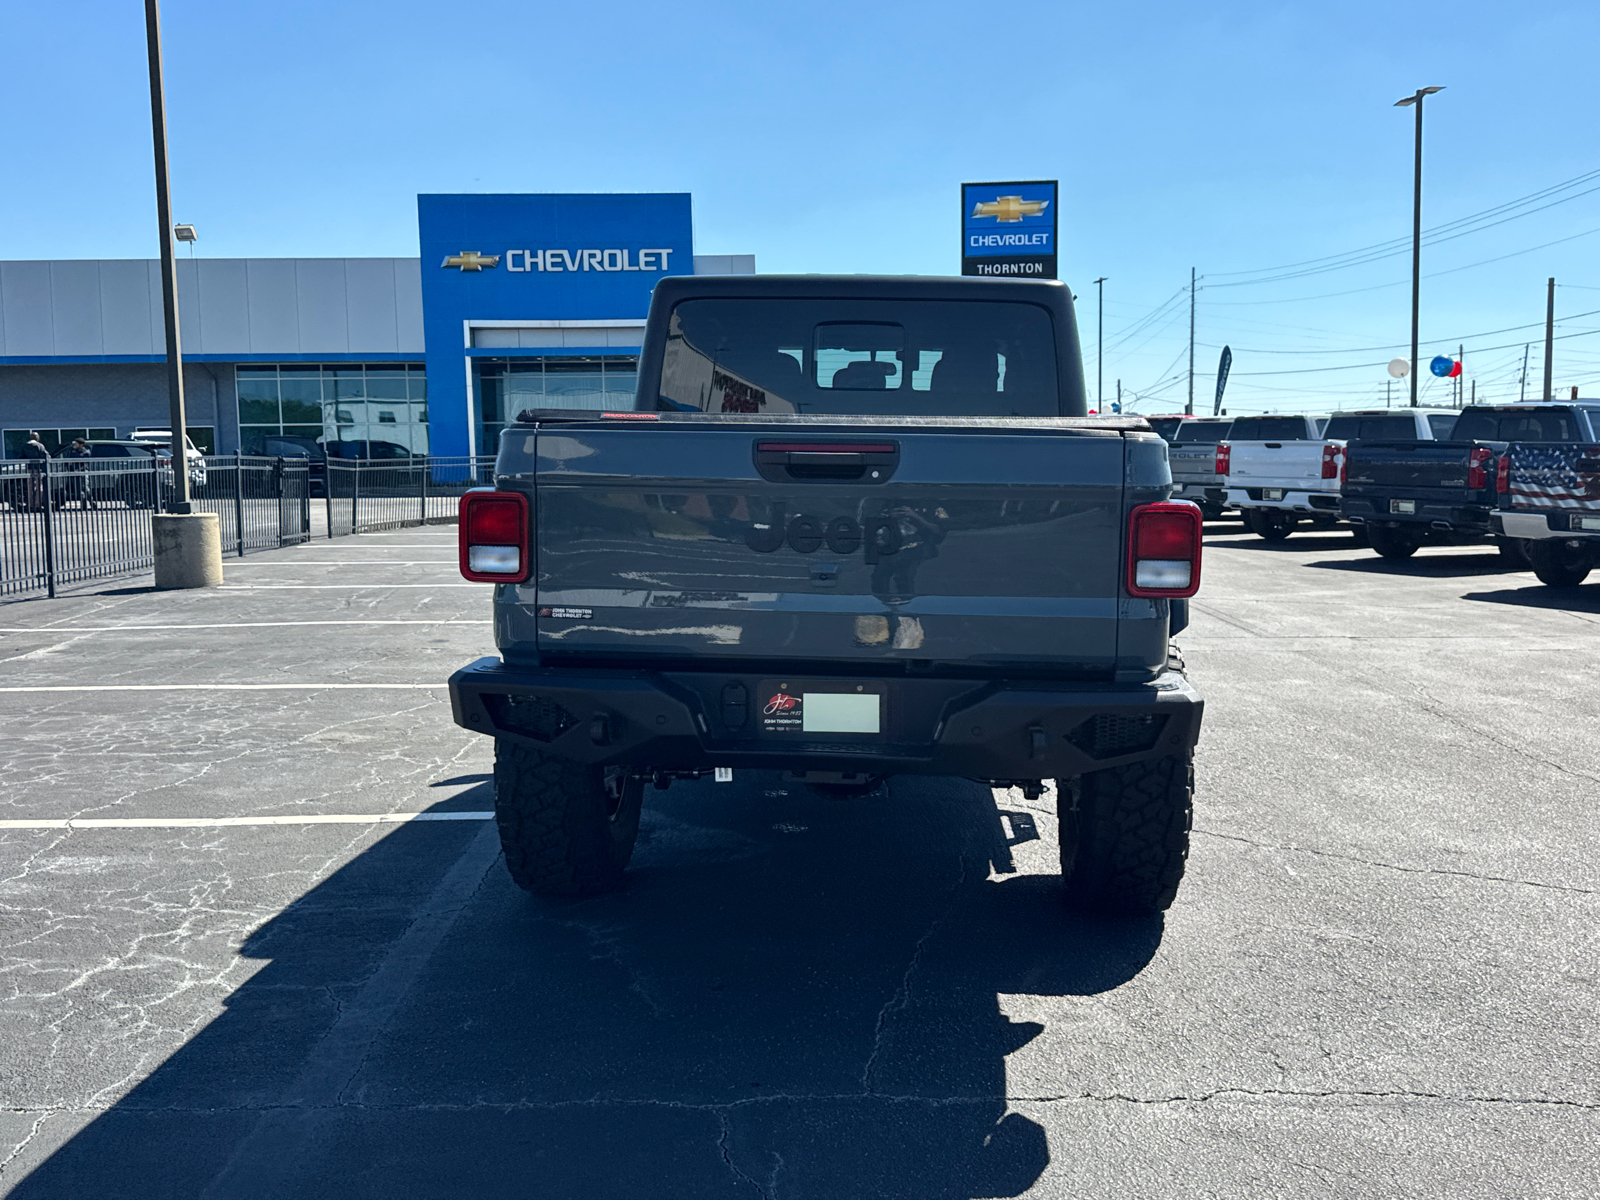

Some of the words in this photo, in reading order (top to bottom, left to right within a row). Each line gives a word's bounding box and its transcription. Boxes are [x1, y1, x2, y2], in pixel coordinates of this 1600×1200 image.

[970, 233, 1049, 247] CHEVROLET
[506, 249, 672, 272] CHEVROLET
[977, 263, 1043, 275] THORNTON
[747, 502, 904, 565] Jeep
